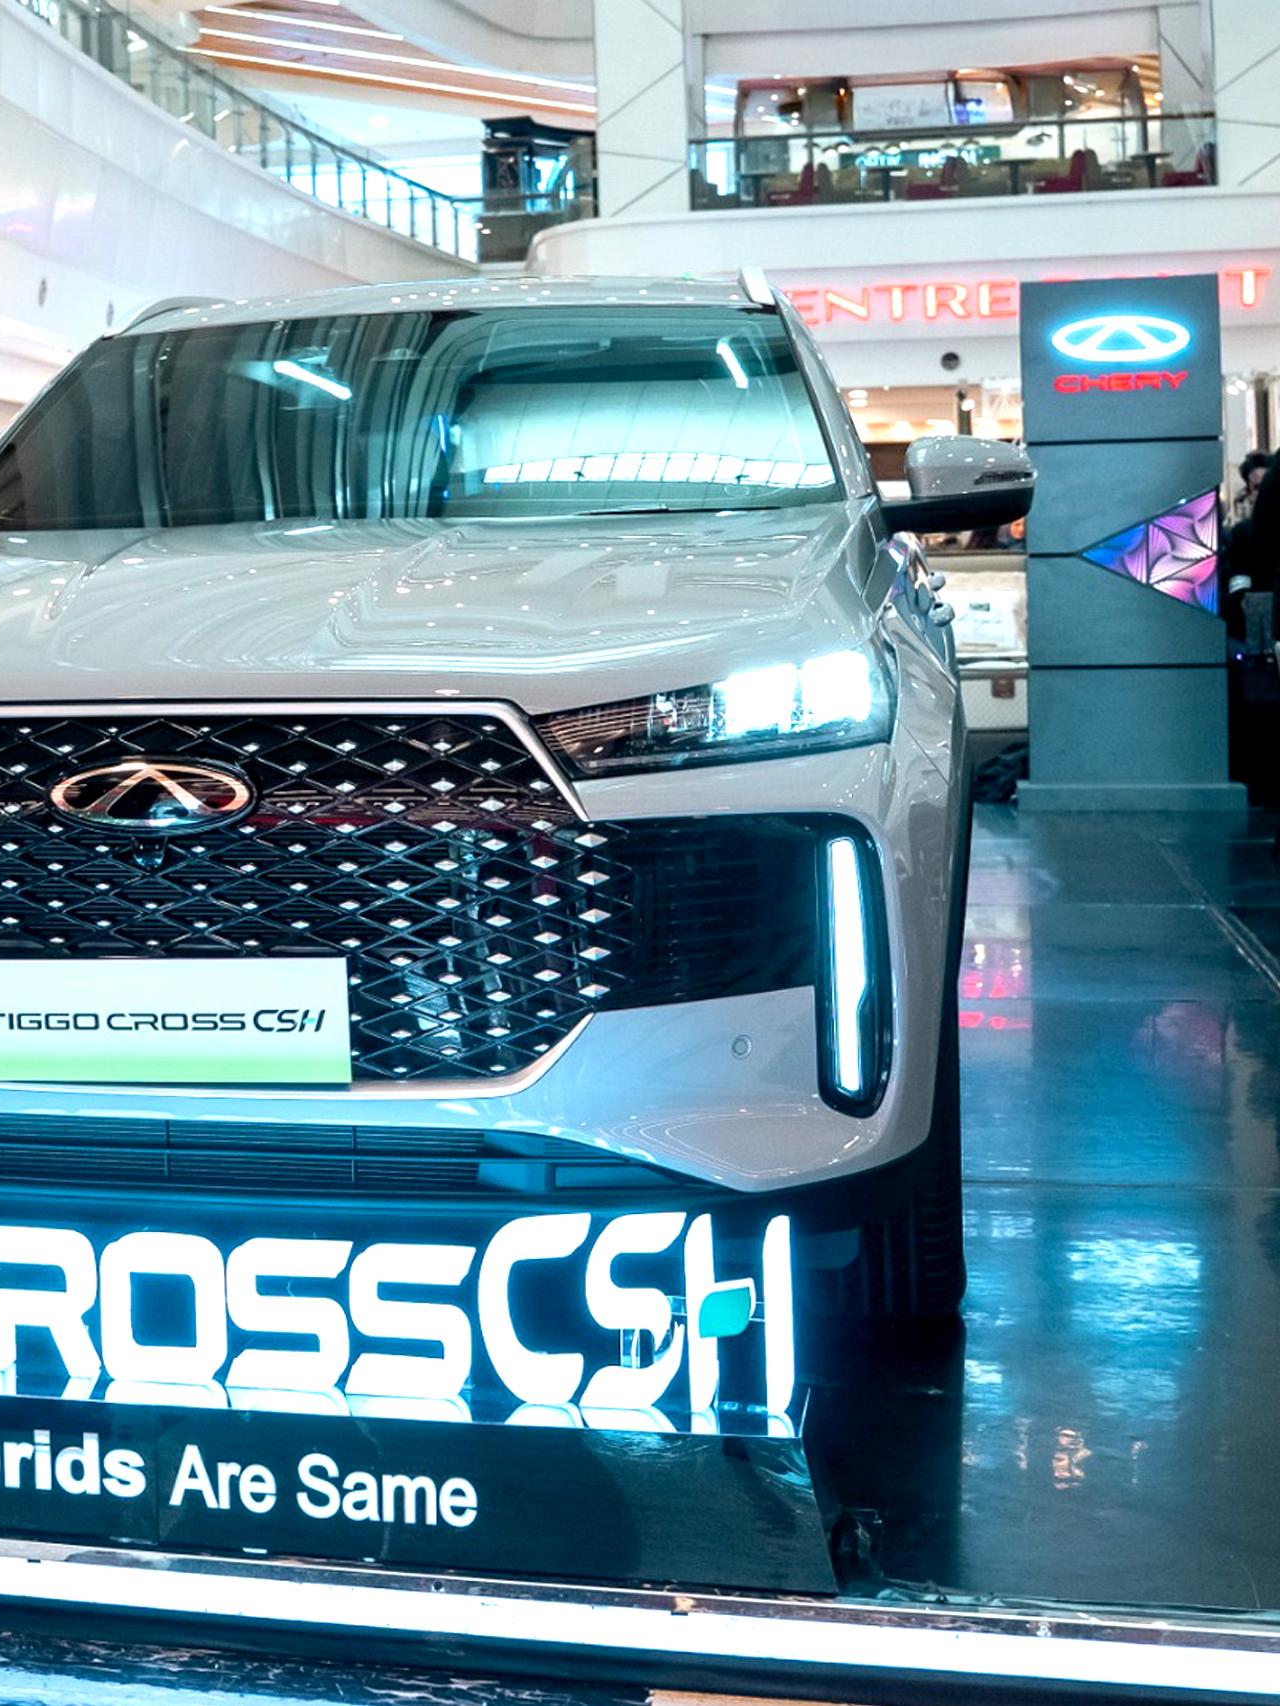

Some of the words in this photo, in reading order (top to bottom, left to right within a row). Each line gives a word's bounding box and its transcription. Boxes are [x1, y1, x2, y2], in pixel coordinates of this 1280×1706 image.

[1052, 370, 1190, 394] CHERY
[106, 1012, 246, 1032] CROSS
[253, 1008, 326, 1033] CSH
[478, 1211, 795, 1414] CSH
[169, 1444, 277, 1515] Are
[296, 1453, 478, 1527] Same
